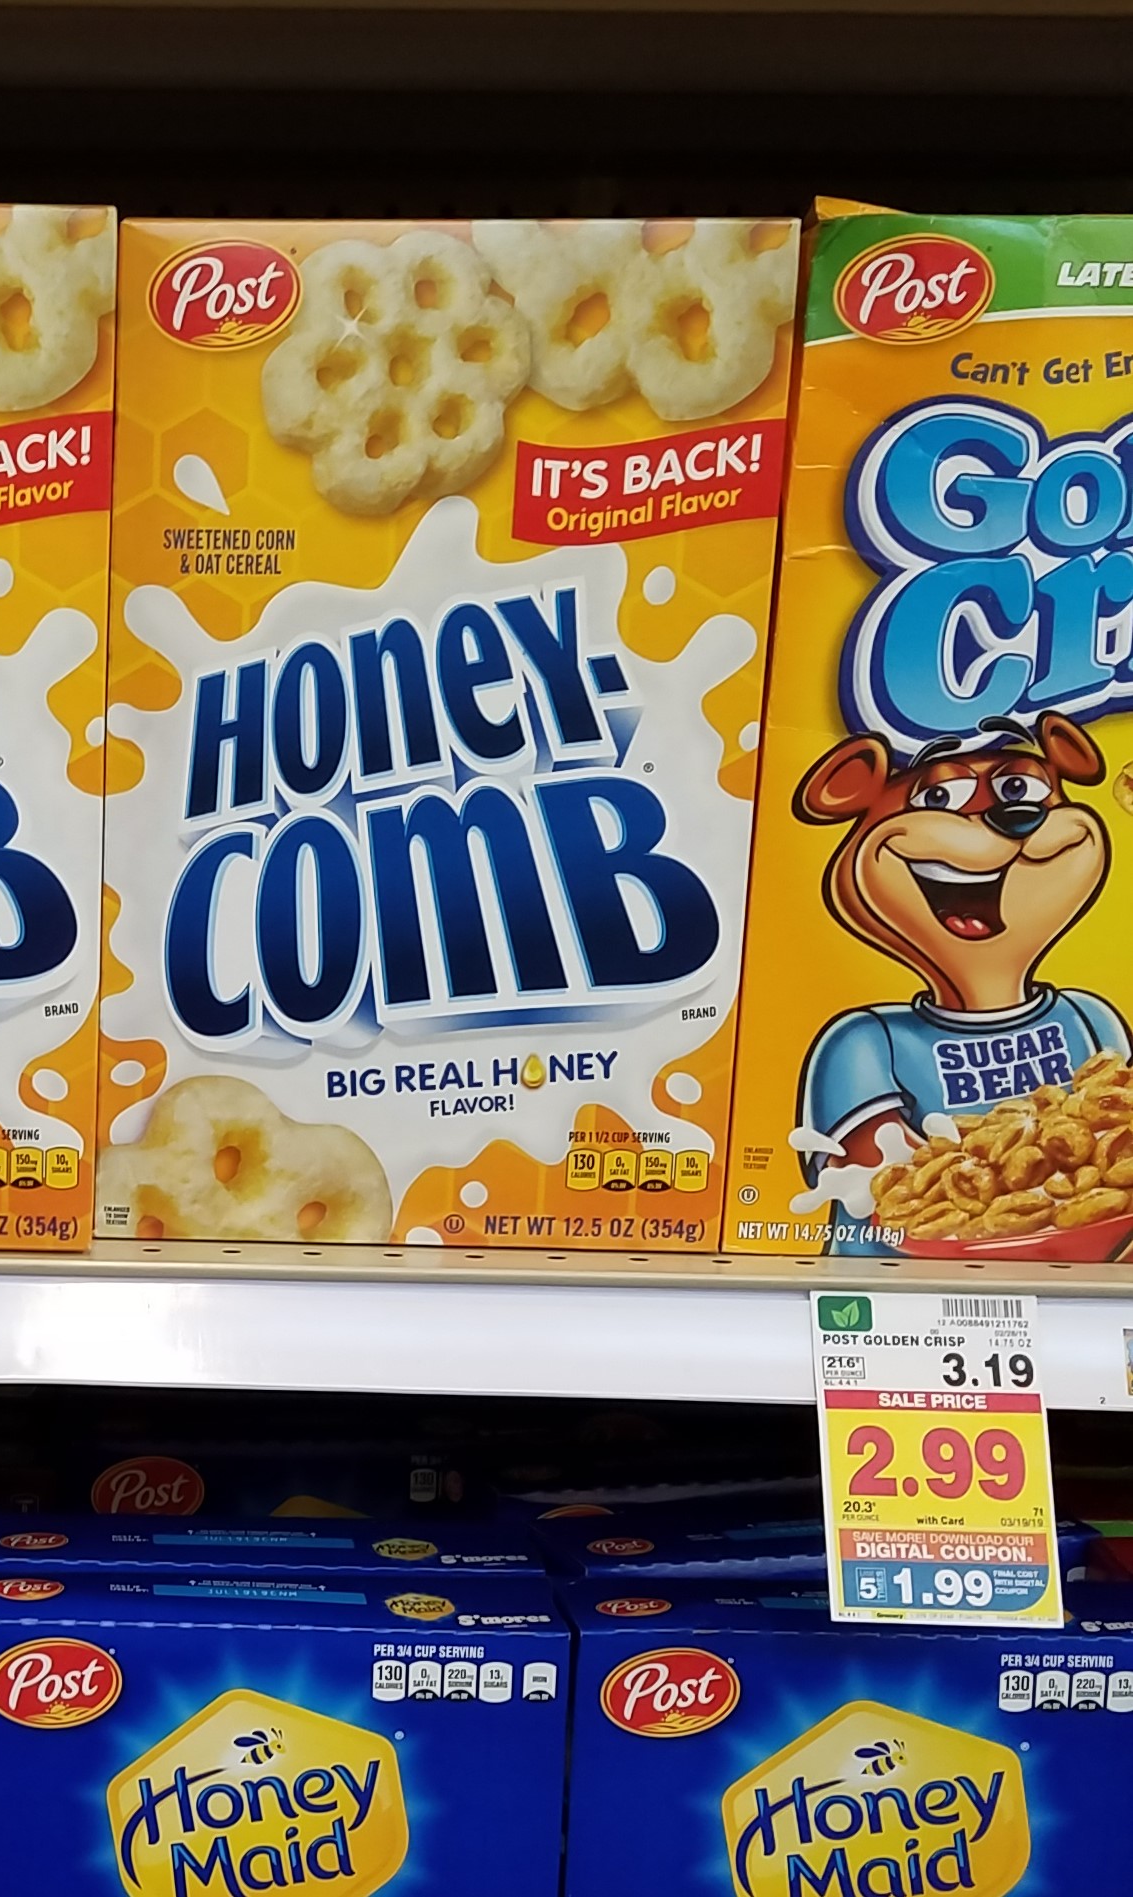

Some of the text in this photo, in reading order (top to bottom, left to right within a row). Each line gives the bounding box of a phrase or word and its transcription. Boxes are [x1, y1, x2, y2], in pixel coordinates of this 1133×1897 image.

[171, 255, 283, 331] Post
[859, 252, 977, 324] Post
[950, 352, 1030, 386] Can't
[1042, 358, 1092, 384] Get
[530, 433, 762, 499] IT'S BACK!
[546, 486, 742, 537] Original Flavor
[162, 528, 295, 552] SWEETENED CORN
[179, 552, 281, 576] & OAT CEREAL
[167, 775, 720, 1037] COMB
[44, 1002, 79, 1018] BRAND
[681, 1006, 716, 1021] BRAND
[936, 1024, 1064, 1070] SUGAR
[327, 1068, 386, 1098] BIG
[394, 1059, 483, 1094] REAL
[942, 1052, 1073, 1106] BEAR
[429, 1093, 515, 1118] FLAVOR!
[2, 1129, 39, 1140] SERVING
[569, 1131, 586, 1143] PER
[612, 1132, 629, 1143] CUP
[632, 1132, 670, 1144] SERVING
[573, 1154, 595, 1170] 130
[16, 1216, 78, 1240] (354g)
[484, 1216, 705, 1243] NET WT 12.5 OZ (354g)
[738, 1222, 904, 1247] NET WT 14.75 OZ (418g)
[823, 1334, 965, 1347] POST GOLDEN CRISP
[943, 1352, 1034, 1388] 3.19
[879, 1393, 987, 1410] SALE PRICE
[846, 1425, 1026, 1500] 2.99
[917, 1516, 964, 1526] with Card
[853, 1532, 1034, 1546] SAVE MORE! DOWNLOAD OUR
[856, 1543, 1032, 1562] DIGITAL COUPON.
[859, 1577, 878, 1599] 5
[893, 1567, 992, 1607] 1.99
[374, 1644, 484, 1658] PER 3/4 CUP SERVING
[1001, 1654, 1113, 1668] PER 3/4 CUP SERVING
[6, 1652, 106, 1711] Post
[377, 1665, 402, 1681] 130
[1004, 1675, 1030, 1691] 130
[622, 1664, 723, 1721] Post
[121, 1760, 380, 1890] Honey
[735, 1770, 1005, 1896] Honey
[170, 1815, 356, 1897] Maid
[786, 1829, 975, 1897] Maid
